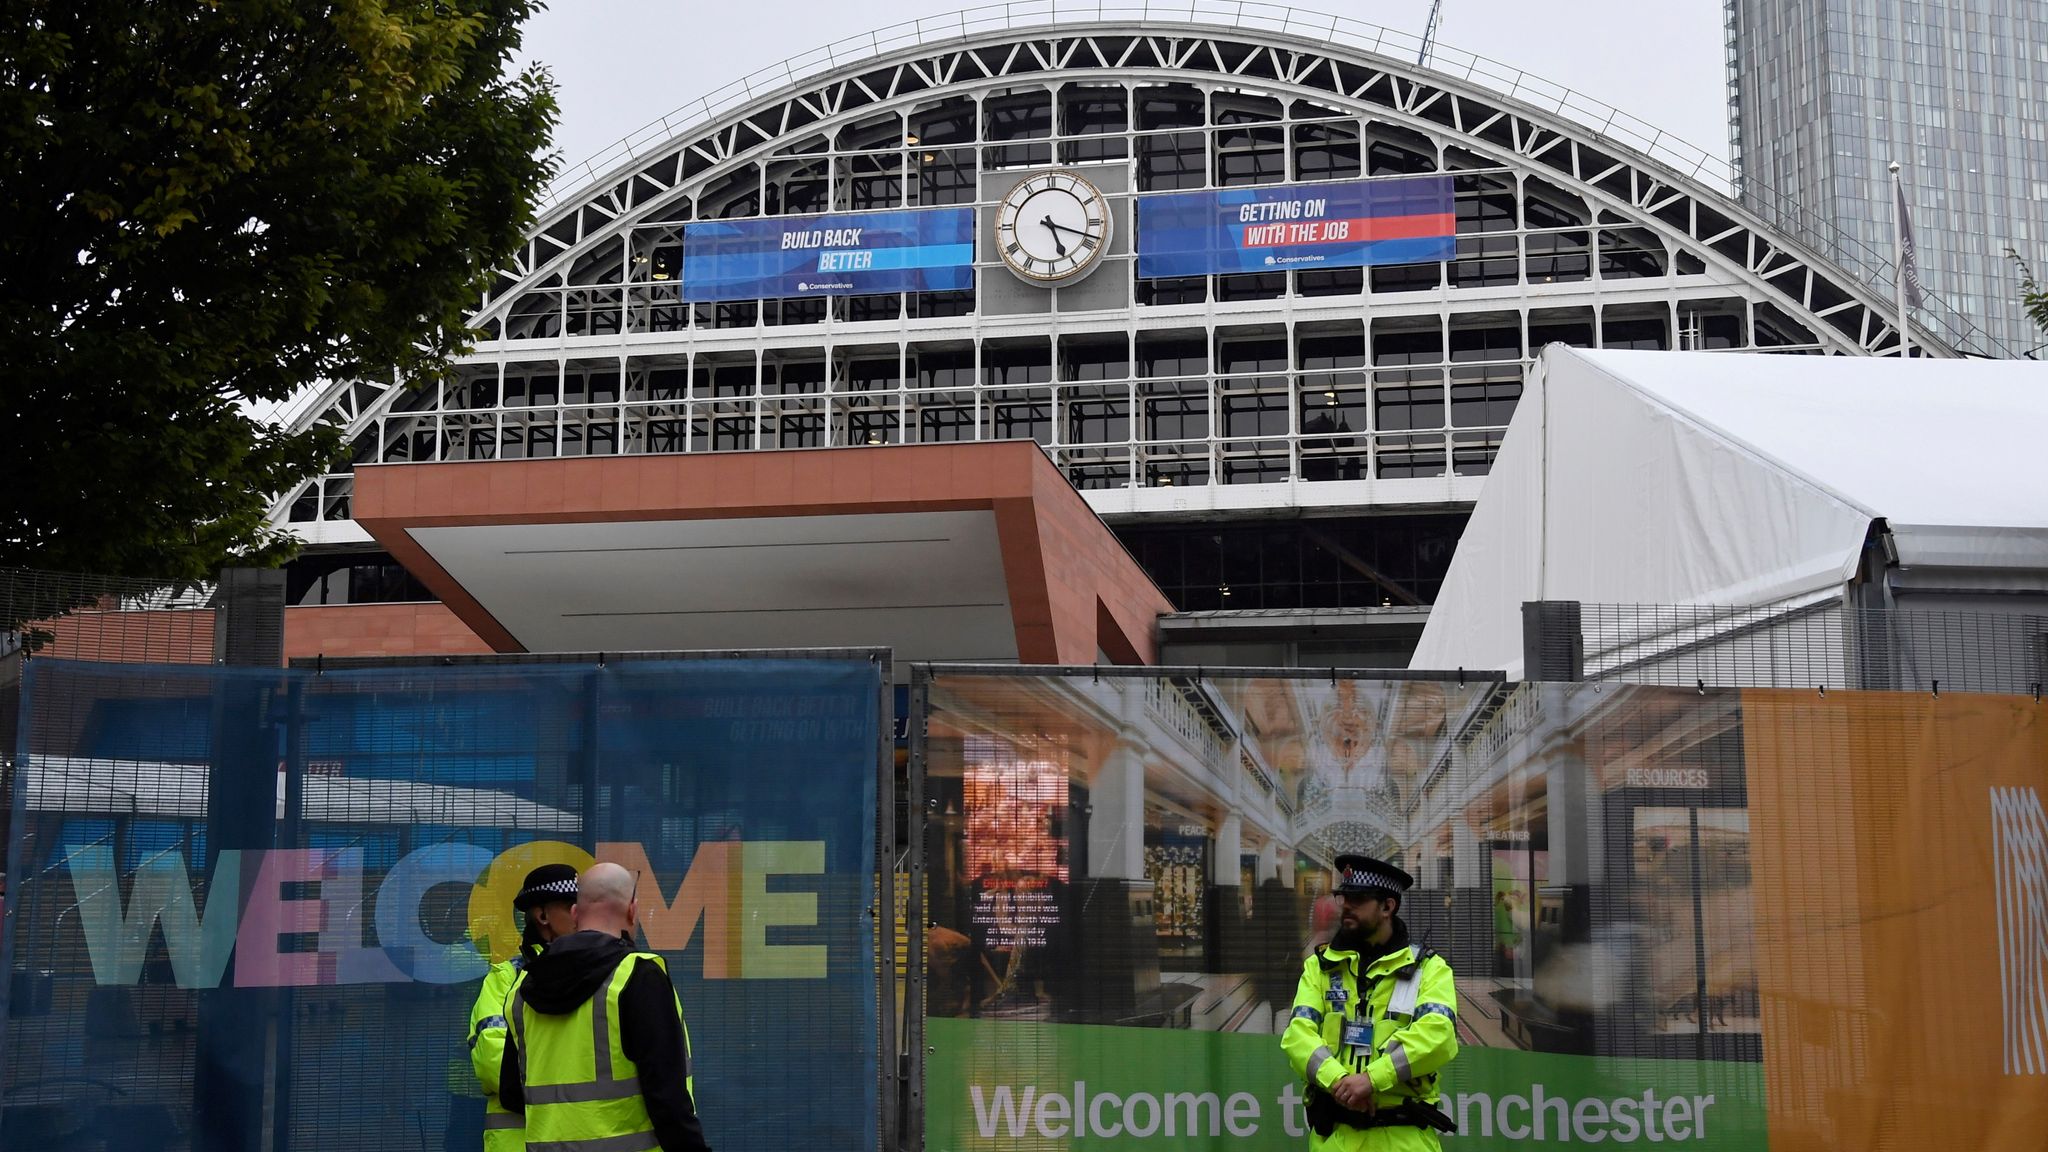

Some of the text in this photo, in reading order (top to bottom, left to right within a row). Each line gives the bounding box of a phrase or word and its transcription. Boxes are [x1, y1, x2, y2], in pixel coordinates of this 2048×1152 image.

[1239, 198, 1326, 222] GETTING ON
[781, 228, 862, 249] BUILD BACK
[1247, 221, 1349, 245] WITH THE JOB
[819, 251, 873, 270] BETTER
[1277, 255, 1325, 263] Conservatives
[809, 282, 853, 290] Conservatives
[797, 695, 856, 717] BETTR
[1627, 768, 1708, 786] RESOURCES
[1178, 825, 1208, 836] PEACE
[1486, 830, 1529, 840] WEATHER
[979, 892, 994, 901] The
[1013, 892, 1053, 901] exhibition
[65, 840, 828, 989] WELCOME
[1002, 903, 1016, 912] the
[1014, 915, 1038, 923] North
[969, 1080, 1715, 1143] Welcome t anchester
